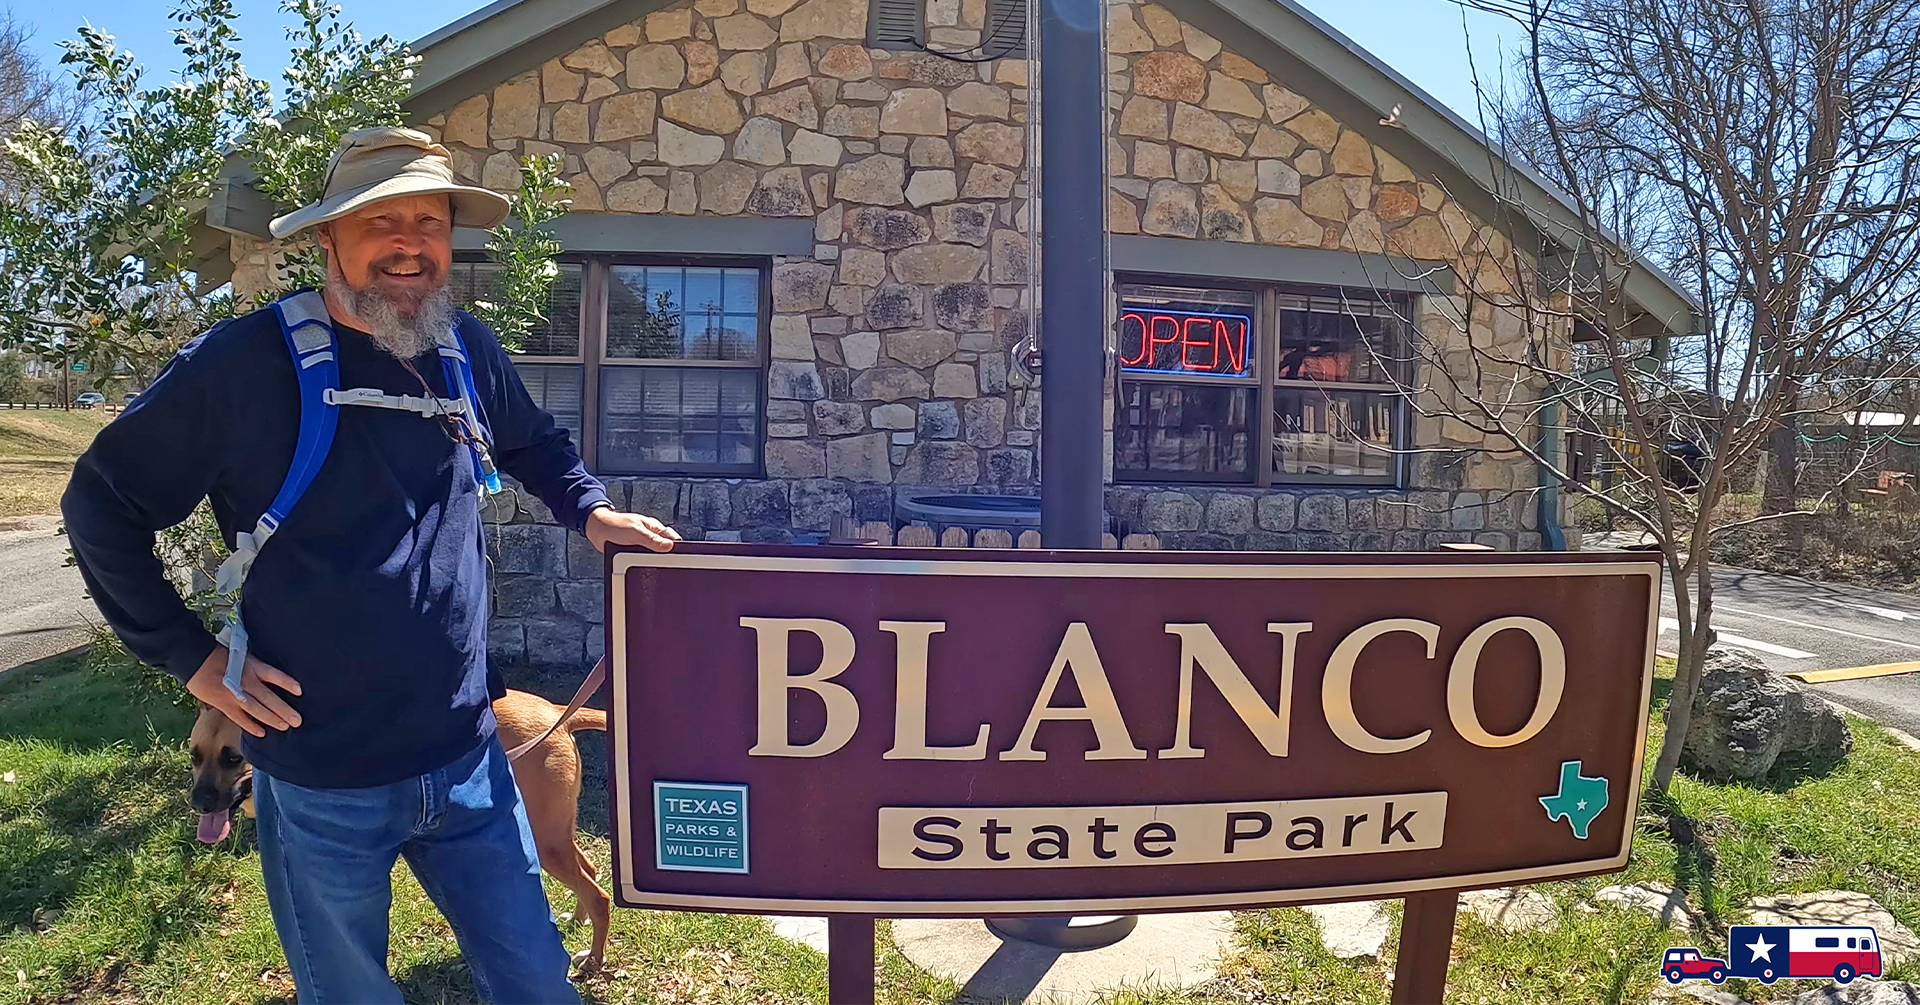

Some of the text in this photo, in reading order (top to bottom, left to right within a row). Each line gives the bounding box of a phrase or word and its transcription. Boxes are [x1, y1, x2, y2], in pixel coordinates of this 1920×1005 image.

[1121, 313, 1245, 372] OPEN
[739, 615, 1567, 761] BLANCO
[664, 798, 738, 815] TEXAS
[665, 823, 737, 837] PARKS &
[911, 802, 1419, 861] State Park
[666, 844, 739, 859] WILDLIFE
